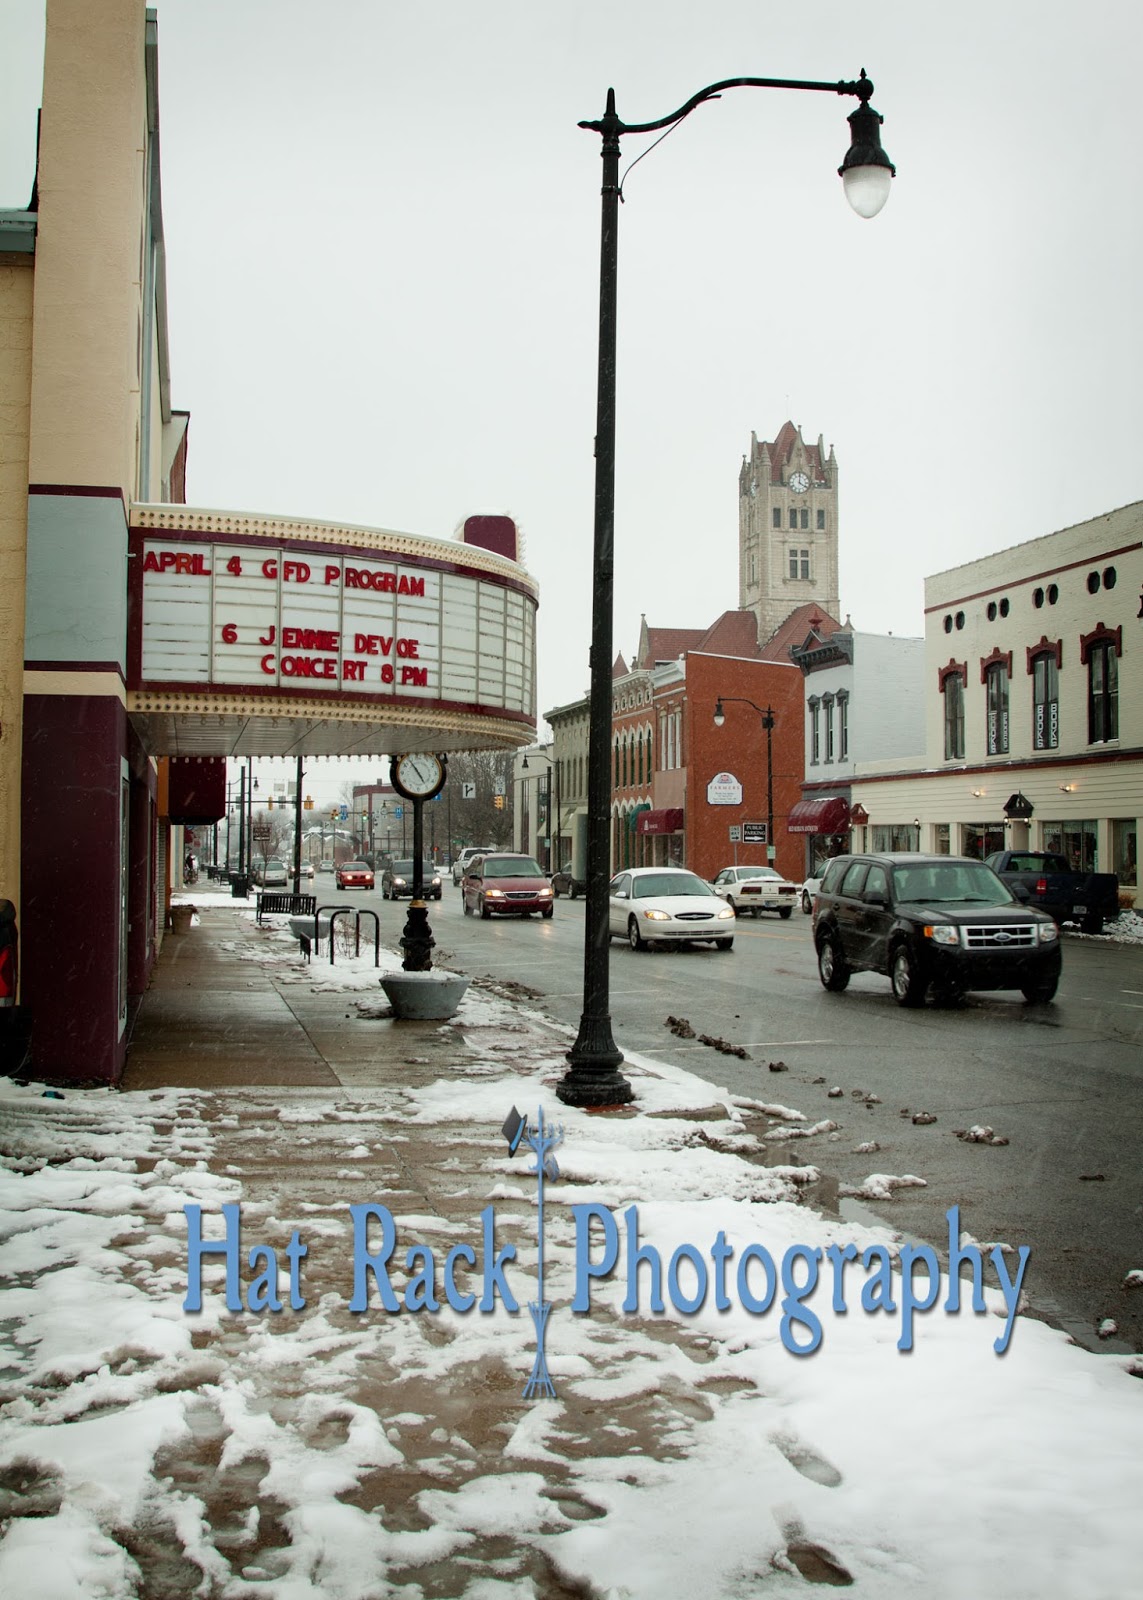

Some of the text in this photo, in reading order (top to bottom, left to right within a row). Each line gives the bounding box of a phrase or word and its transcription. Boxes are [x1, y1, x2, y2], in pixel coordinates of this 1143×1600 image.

[143, 551, 425, 597] APRIL 4 GFD PROGRAM
[222, 623, 238, 644] 6
[259, 625, 340, 653] JENNIE
[261, 654, 428, 687] CONCERT 8 PM
